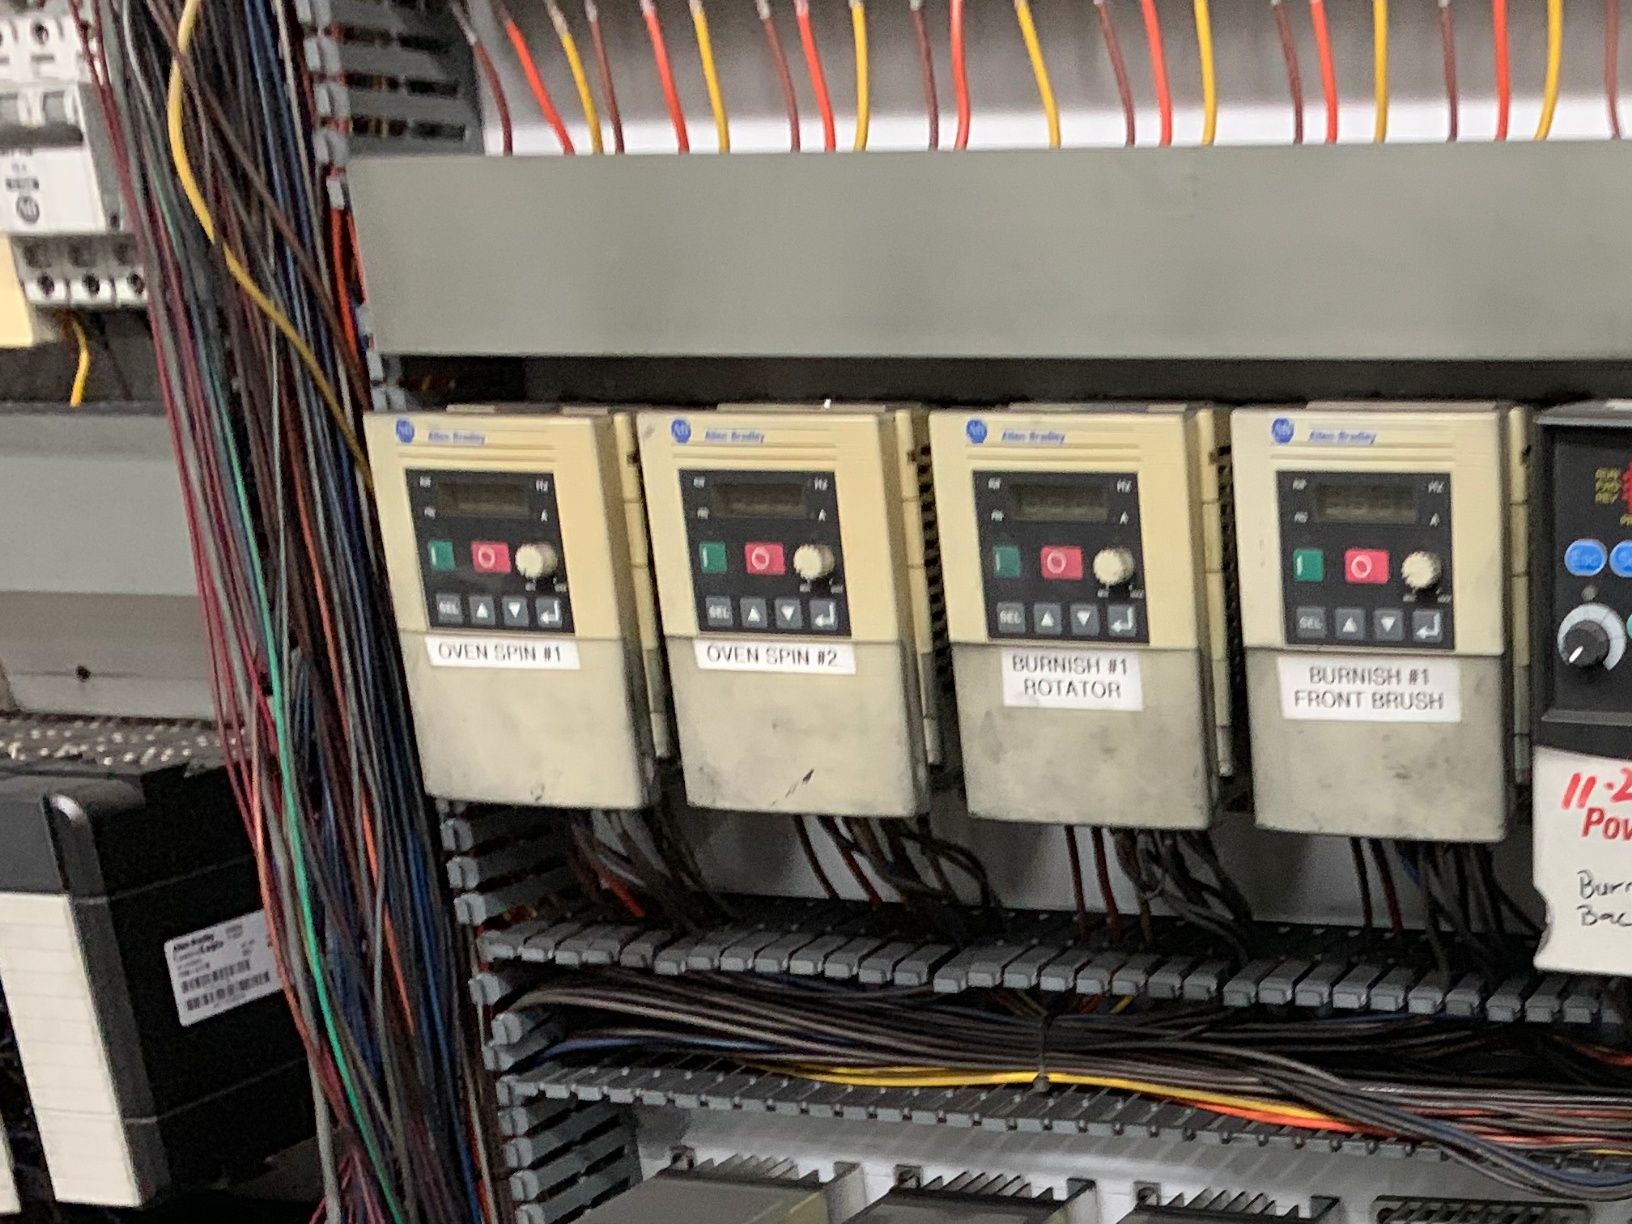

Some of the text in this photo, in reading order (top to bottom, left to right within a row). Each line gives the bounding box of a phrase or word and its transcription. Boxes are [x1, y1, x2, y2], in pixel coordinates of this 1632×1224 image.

[438, 641, 561, 662] OVEN SPIN #1
[706, 645, 838, 667] OVEN SPIN #2
[1012, 654, 1129, 675] BURNISH #1
[1309, 666, 1430, 685] BURNISH #1
[1023, 678, 1122, 699] ROTATOR
[1293, 689, 1444, 710] FRONT BRUSH
